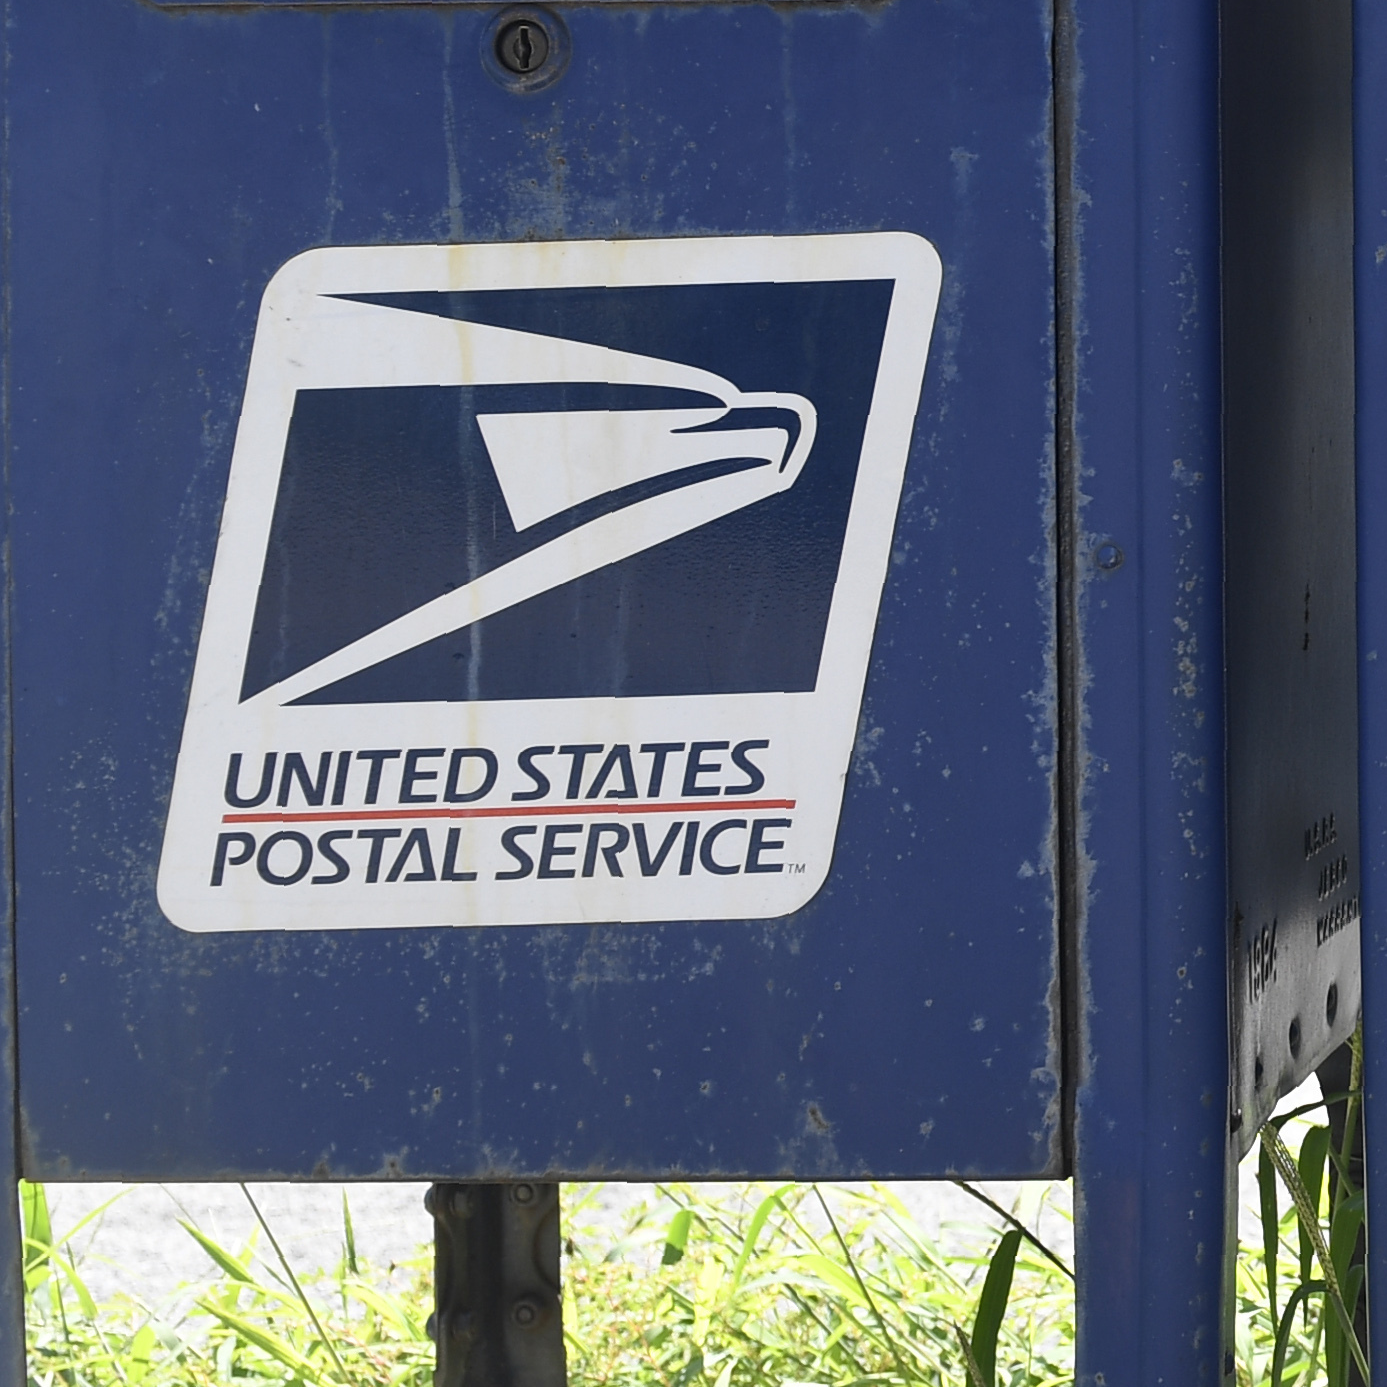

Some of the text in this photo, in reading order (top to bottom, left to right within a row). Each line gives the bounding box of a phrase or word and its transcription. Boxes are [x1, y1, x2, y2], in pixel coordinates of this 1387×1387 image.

[225, 740, 769, 808] UNITED STATES
[211, 828, 477, 886] POSTAL
[495, 818, 792, 880] SERVICE
